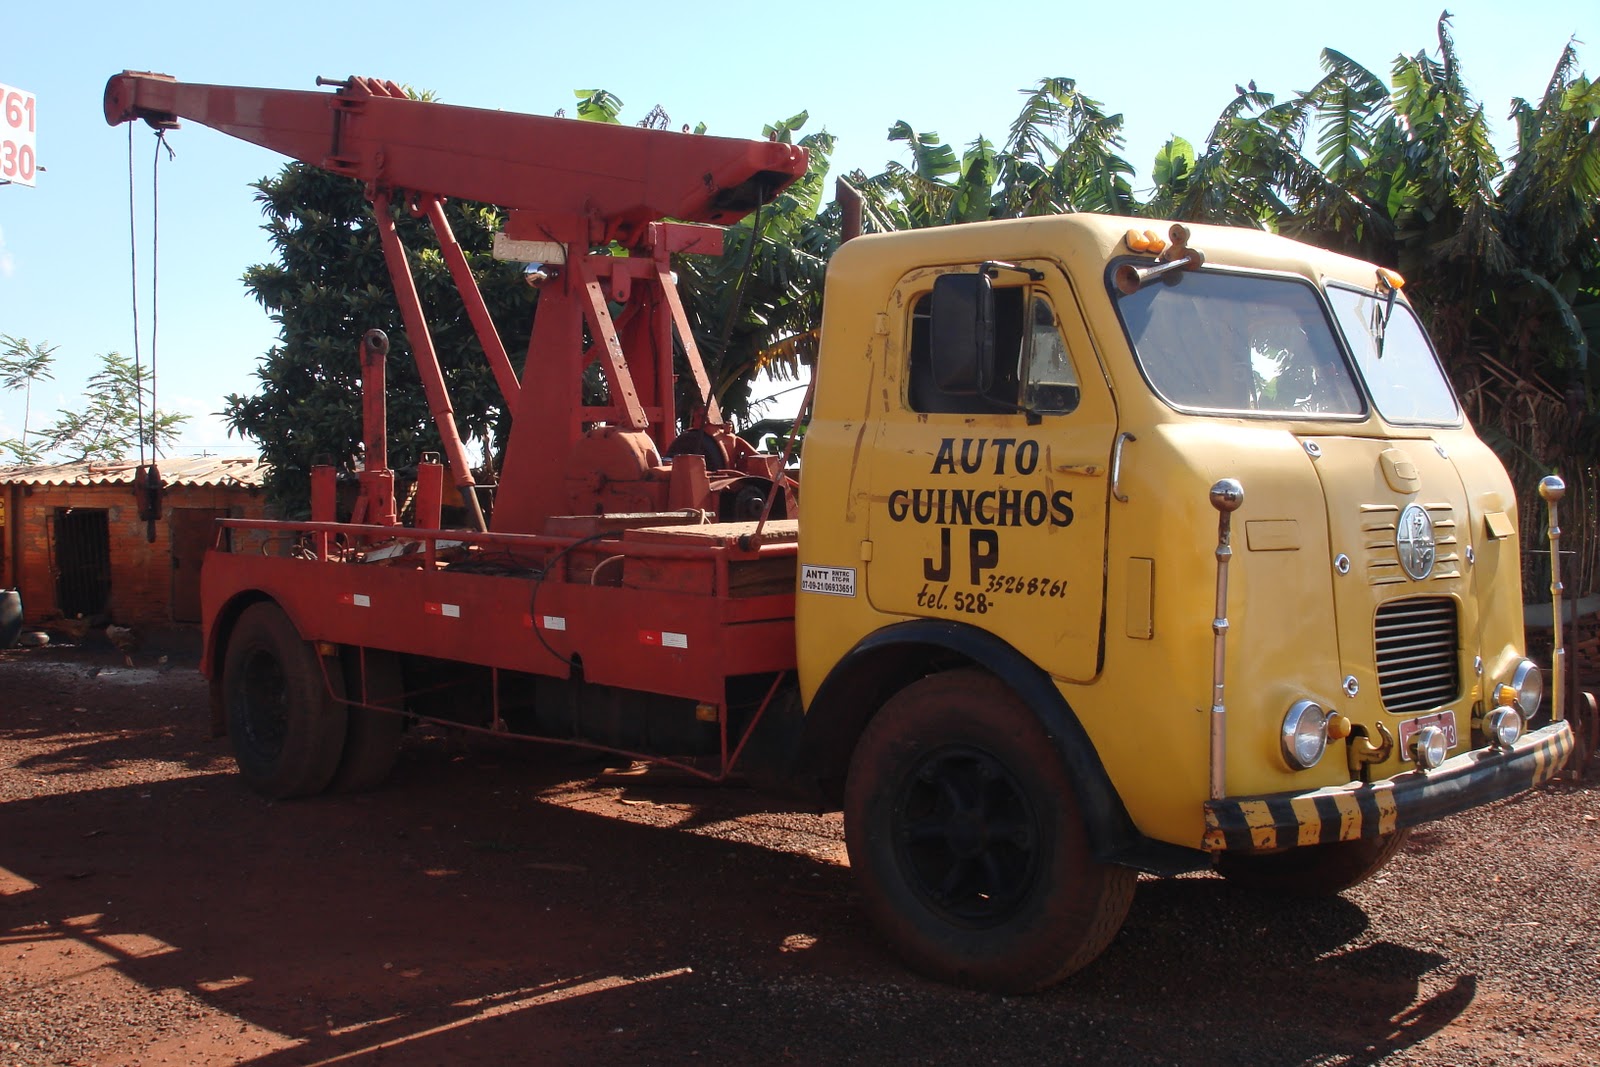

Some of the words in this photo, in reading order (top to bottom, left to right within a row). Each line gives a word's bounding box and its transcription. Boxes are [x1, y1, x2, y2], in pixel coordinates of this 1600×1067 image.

[0, 140, 35, 181] 30
[930, 438, 1040, 475] AUTO
[888, 488, 1074, 527] GUINCHOS
[806, 570, 829, 580] ANTT
[985, 574, 1068, 599] 35268761
[916, 583, 948, 611] tel.
